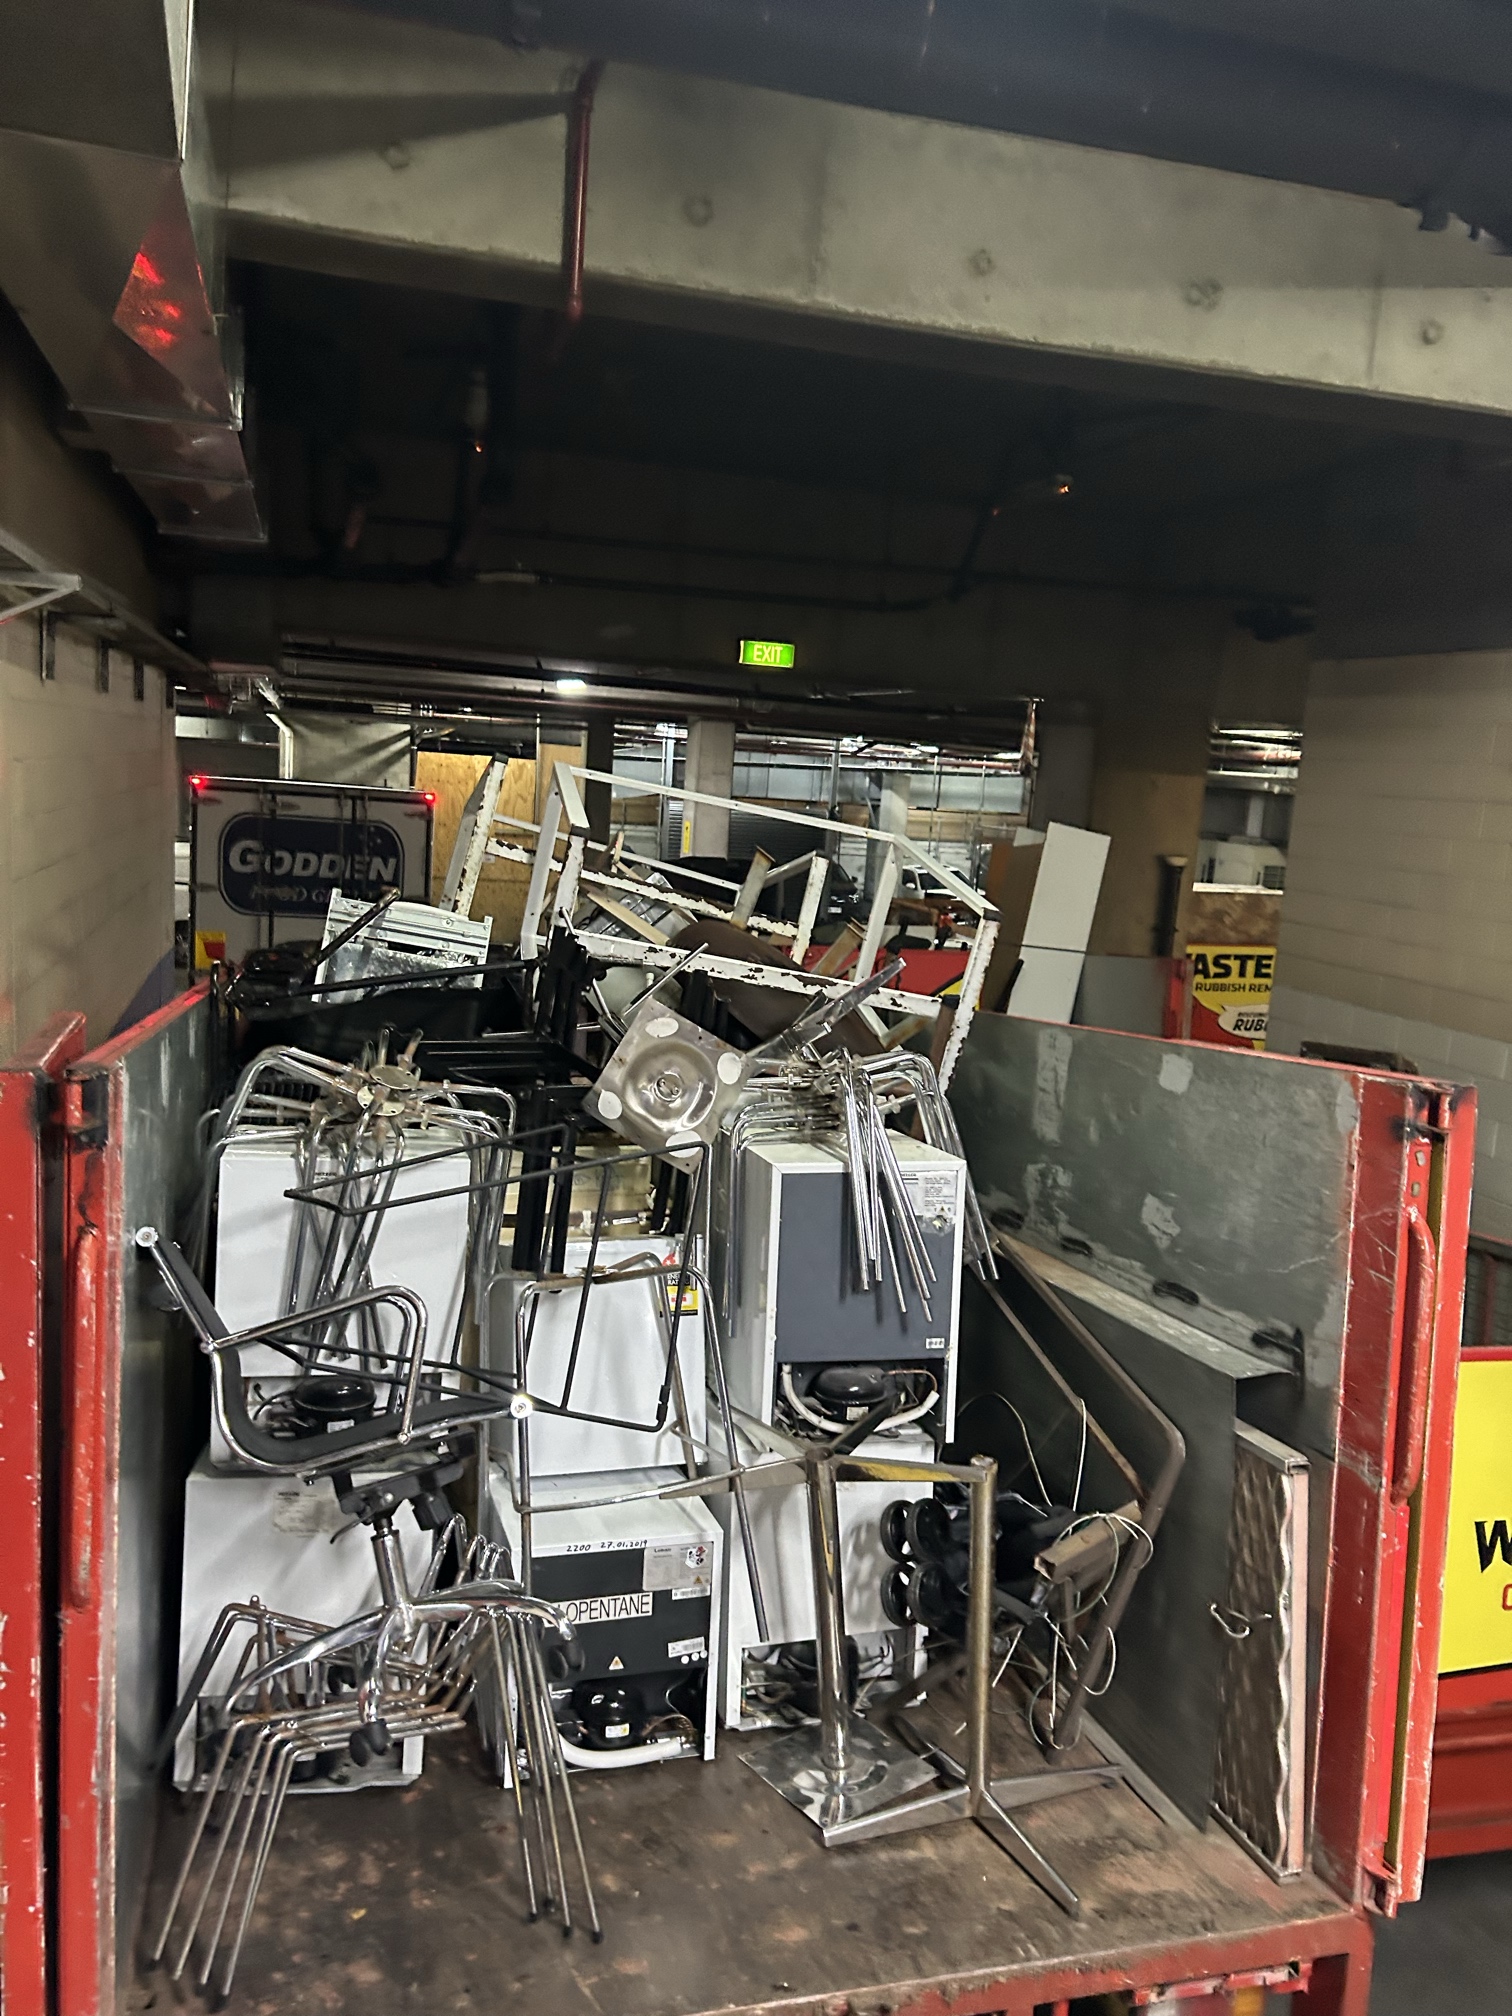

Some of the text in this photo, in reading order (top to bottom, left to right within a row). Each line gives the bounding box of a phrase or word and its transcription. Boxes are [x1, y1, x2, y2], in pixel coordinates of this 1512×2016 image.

[753, 643, 783, 663] EXIT
[229, 839, 397, 883] GODDEN
[1186, 953, 1274, 979] ASTE
[1195, 982, 1246, 993] RUBBISH
[566, 1539, 648, 1552] 2200 27.01.2019
[556, 1594, 650, 1623] OPENTANE
